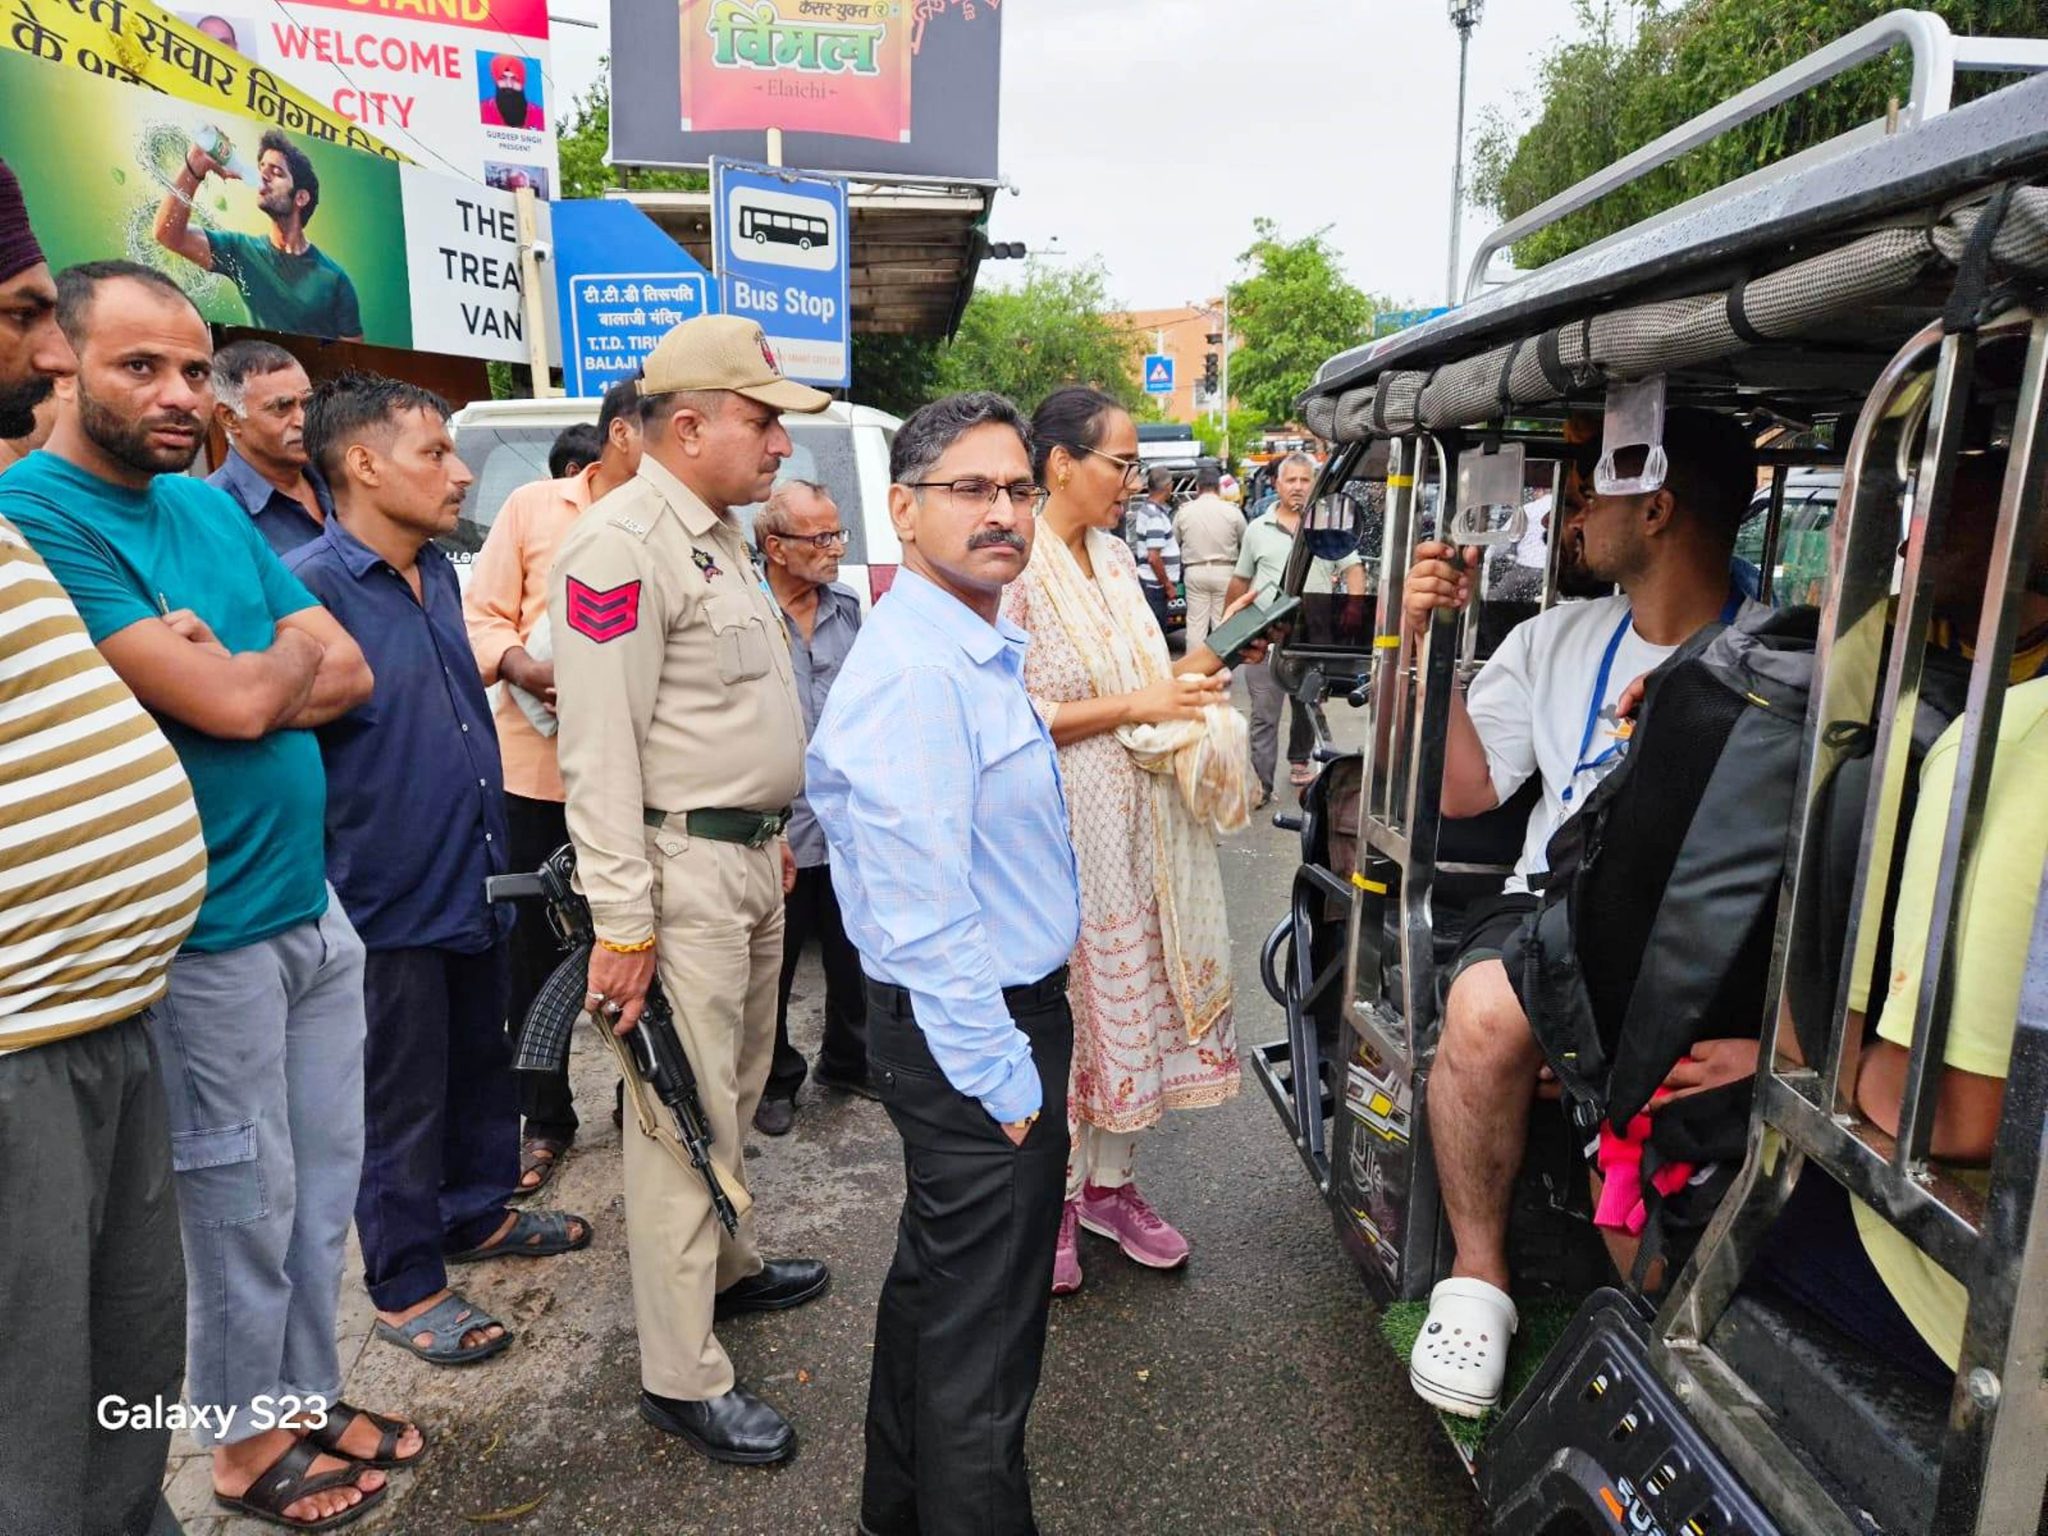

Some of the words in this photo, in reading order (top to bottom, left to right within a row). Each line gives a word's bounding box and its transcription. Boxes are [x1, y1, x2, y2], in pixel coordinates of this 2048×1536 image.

[271, 22, 462, 80] WELCOME
[332, 87, 415, 129] CITY
[767, 79, 827, 99] Elaichi
[455, 198, 517, 243] THE
[438, 246, 523, 294] TREA
[460, 302, 523, 342] VAN
[597, 307, 647, 327] बालाजी
[734, 280, 779, 313] Bus
[784, 286, 836, 325] Stop
[584, 355, 638, 371] BALAJI
[586, 335, 625, 351] T.T.D.
[627, 335, 662, 350] TIRU
